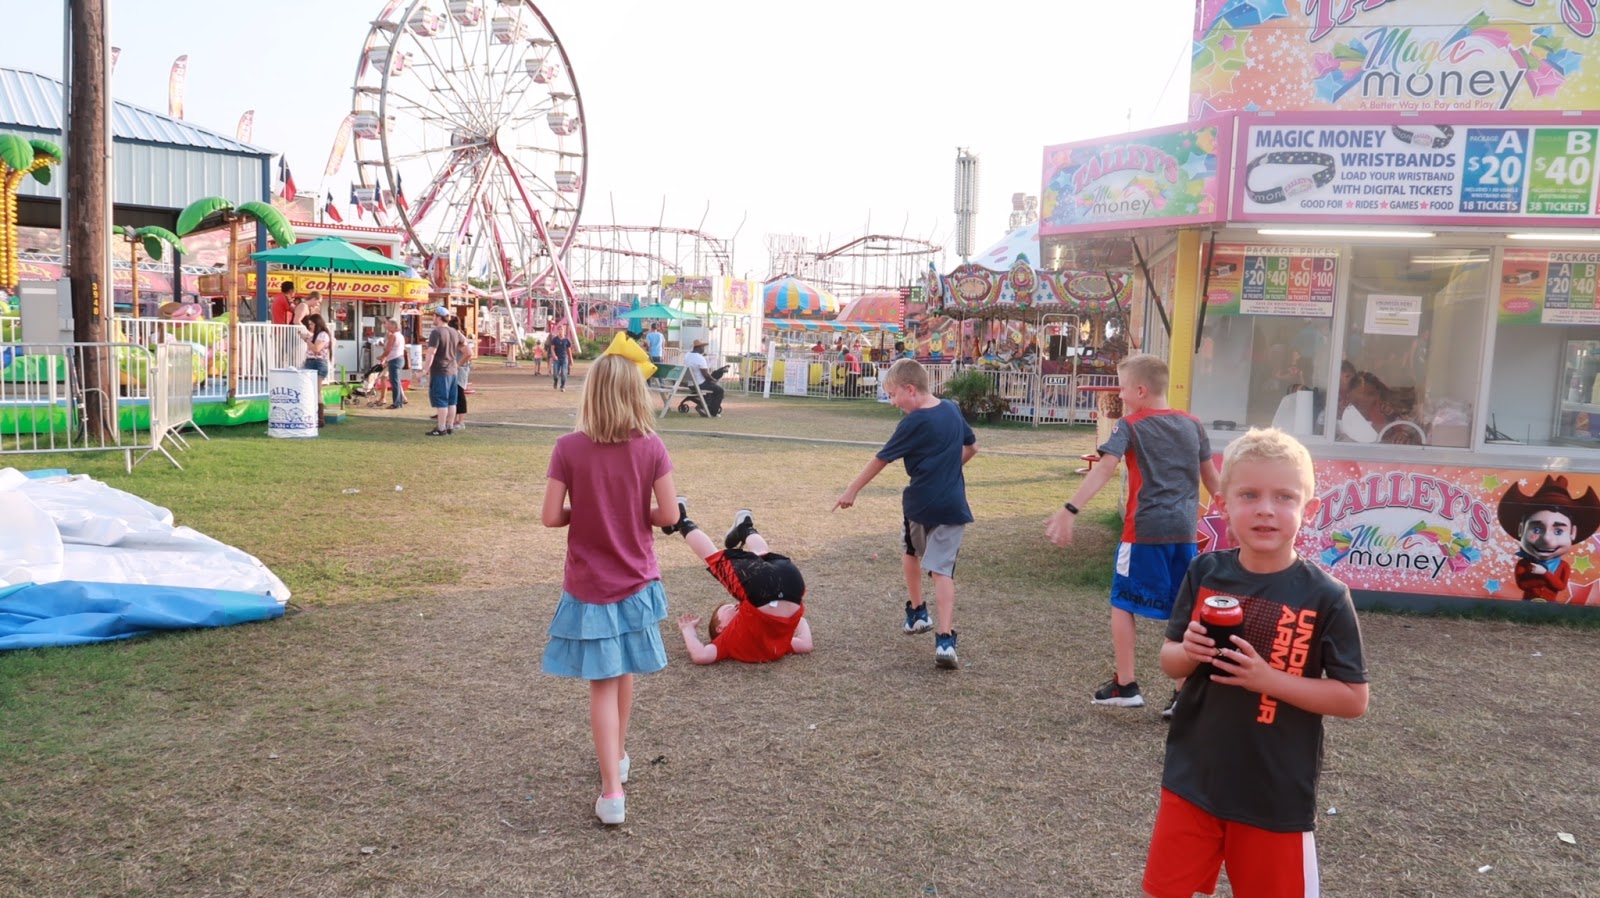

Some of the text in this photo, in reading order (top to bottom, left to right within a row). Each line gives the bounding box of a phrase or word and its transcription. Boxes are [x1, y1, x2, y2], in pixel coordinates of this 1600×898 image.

[1364, 25, 1484, 75] Magic
[1362, 69, 1527, 110] money
[1360, 101, 1494, 110] A Better Way to Pay and Play
[1256, 130, 1386, 148] MAGIC MONEY
[1495, 130, 1523, 154] A
[1566, 130, 1592, 155] B
[1341, 153, 1456, 167] WRISTBANDS
[1072, 144, 1179, 194] TALLEY'S
[1341, 172, 1455, 181] LOAD YOUR WRISTBAND
[1468, 156, 1522, 185] $20
[1535, 156, 1591, 185] $40
[1333, 185, 1453, 196] WITH DIGITAL TICKETS
[1093, 199, 1151, 216] money
[1300, 200, 1454, 210] GOOD FOR RIDES GAMES FOOD
[1463, 201, 1518, 211] 18 TICKETS
[1544, 202, 1587, 212] TICKETS
[1255, 257, 1265, 269] A
[1279, 257, 1288, 270] B
[1301, 258, 1311, 271] C
[1323, 259, 1334, 271] D
[1559, 264, 1570, 277] A
[1585, 264, 1595, 277] B
[1245, 270, 1265, 286] $20
[1268, 271, 1287, 286] $40
[1291, 271, 1310, 287] $60
[1312, 272, 1333, 287] $100
[1547, 277, 1569, 294] $20
[1573, 278, 1594, 294] $40
[305, 280, 390, 294] CORN DOGS
[270, 387, 301, 399] ALLEY
[1318, 473, 1491, 541] TALLEY'S
[1351, 524, 1423, 554] Magic
[1350, 549, 1447, 579] money
[1287, 609, 1317, 677] UNDE
[1257, 605, 1297, 724] ARMUR
